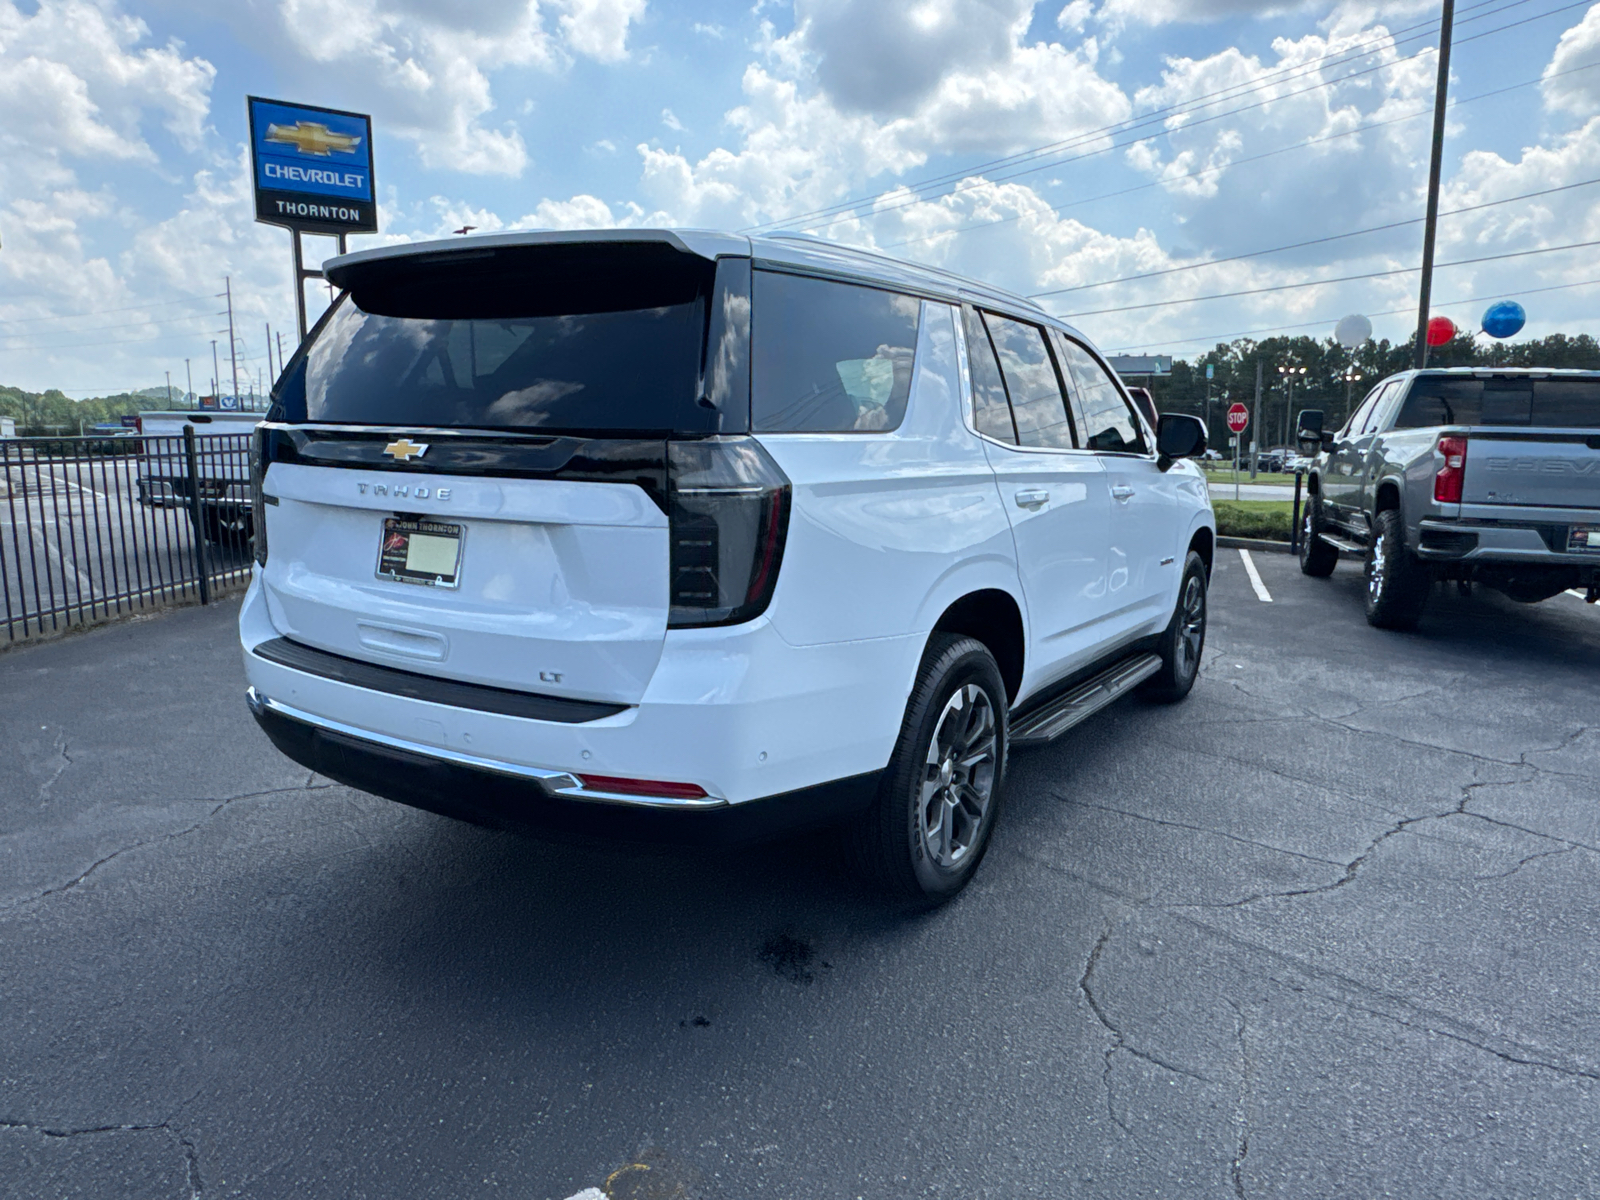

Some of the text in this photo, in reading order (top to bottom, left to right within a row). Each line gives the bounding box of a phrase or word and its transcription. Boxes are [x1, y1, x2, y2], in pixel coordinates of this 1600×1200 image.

[264, 163, 364, 188] CHEVROLET
[275, 200, 361, 221] THORNTON
[1228, 412, 1247, 424] STOP
[1485, 457, 1600, 474] CHEV
[357, 483, 452, 500] TAHOE
[419, 523, 459, 534] THORNTON
[539, 671, 565, 683] LT
